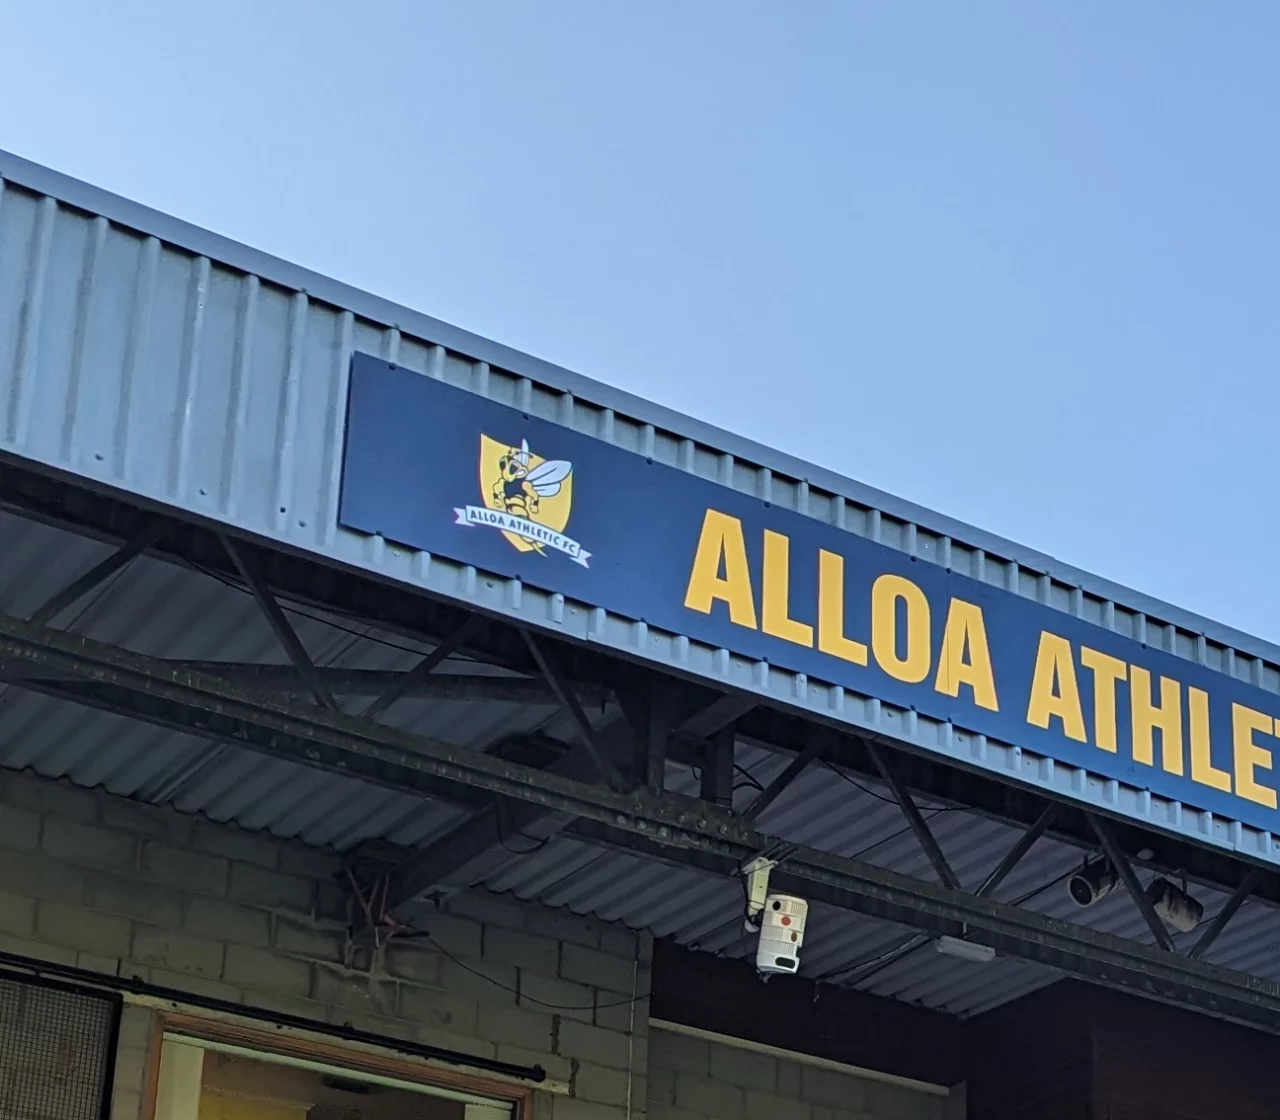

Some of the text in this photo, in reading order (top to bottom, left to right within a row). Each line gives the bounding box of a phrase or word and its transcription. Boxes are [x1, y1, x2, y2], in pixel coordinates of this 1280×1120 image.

[470, 509, 576, 553] ALLOA ATHLETIC FC
[684, 507, 998, 713] ALLOA
